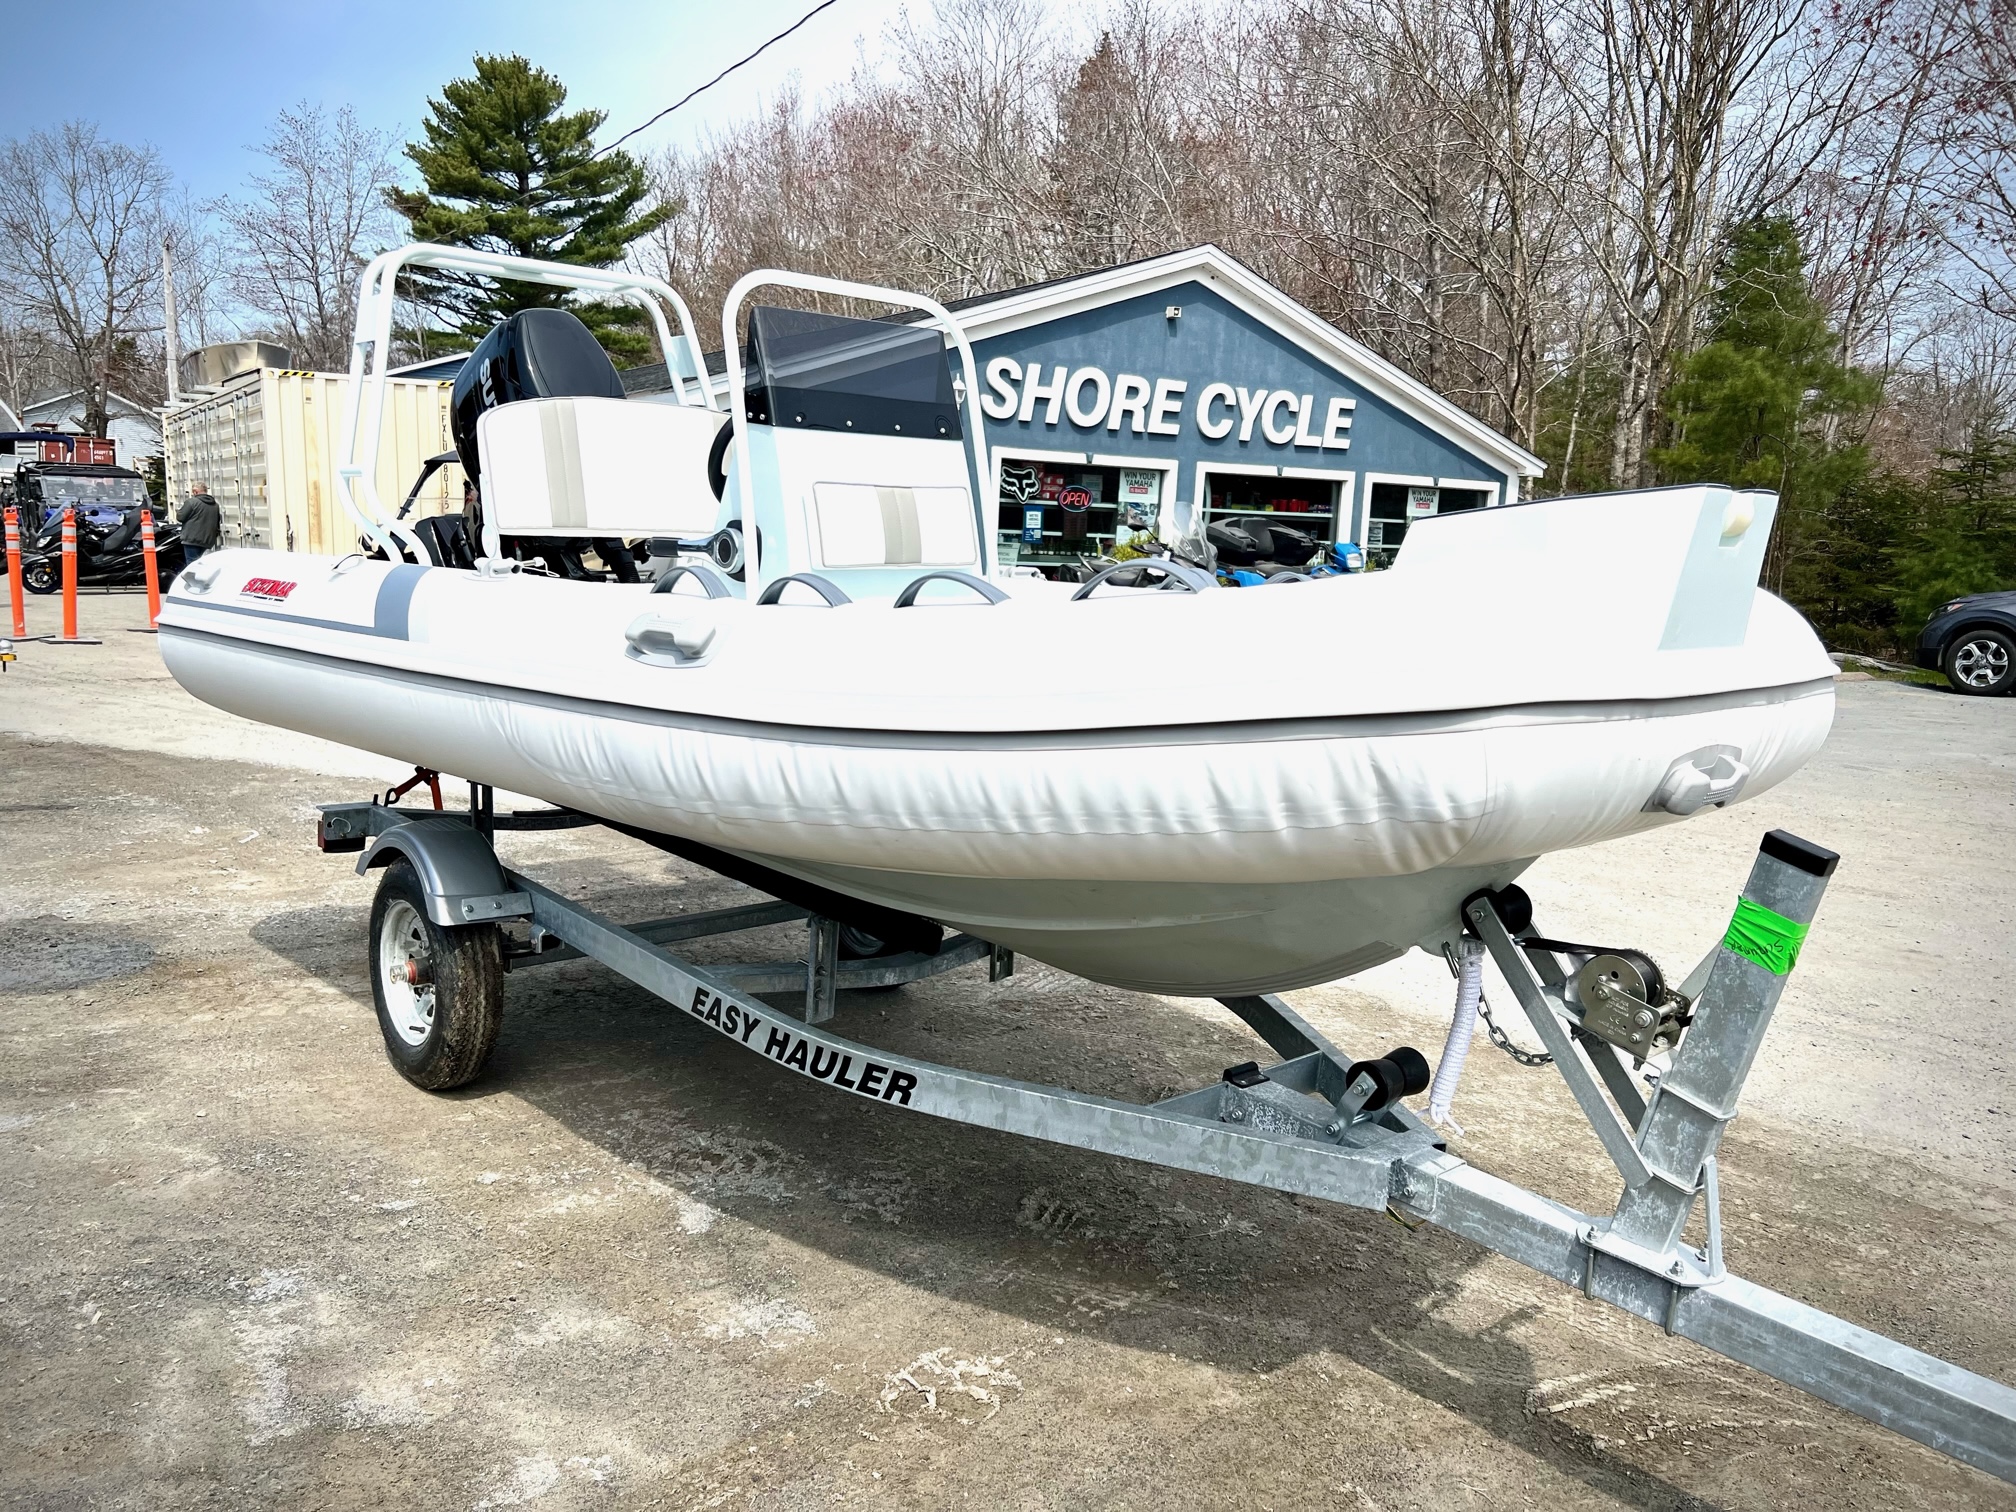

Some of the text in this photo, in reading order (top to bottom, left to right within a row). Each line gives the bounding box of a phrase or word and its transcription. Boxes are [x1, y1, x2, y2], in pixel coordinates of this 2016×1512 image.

[980, 357, 1357, 450] SHORE CYCLE
[1124, 471, 1156, 480] WIN YOUR
[1126, 479, 1153, 487] YAMAHA
[1061, 492, 1090, 506] OPEN
[690, 986, 918, 1106] EASY HAULER
